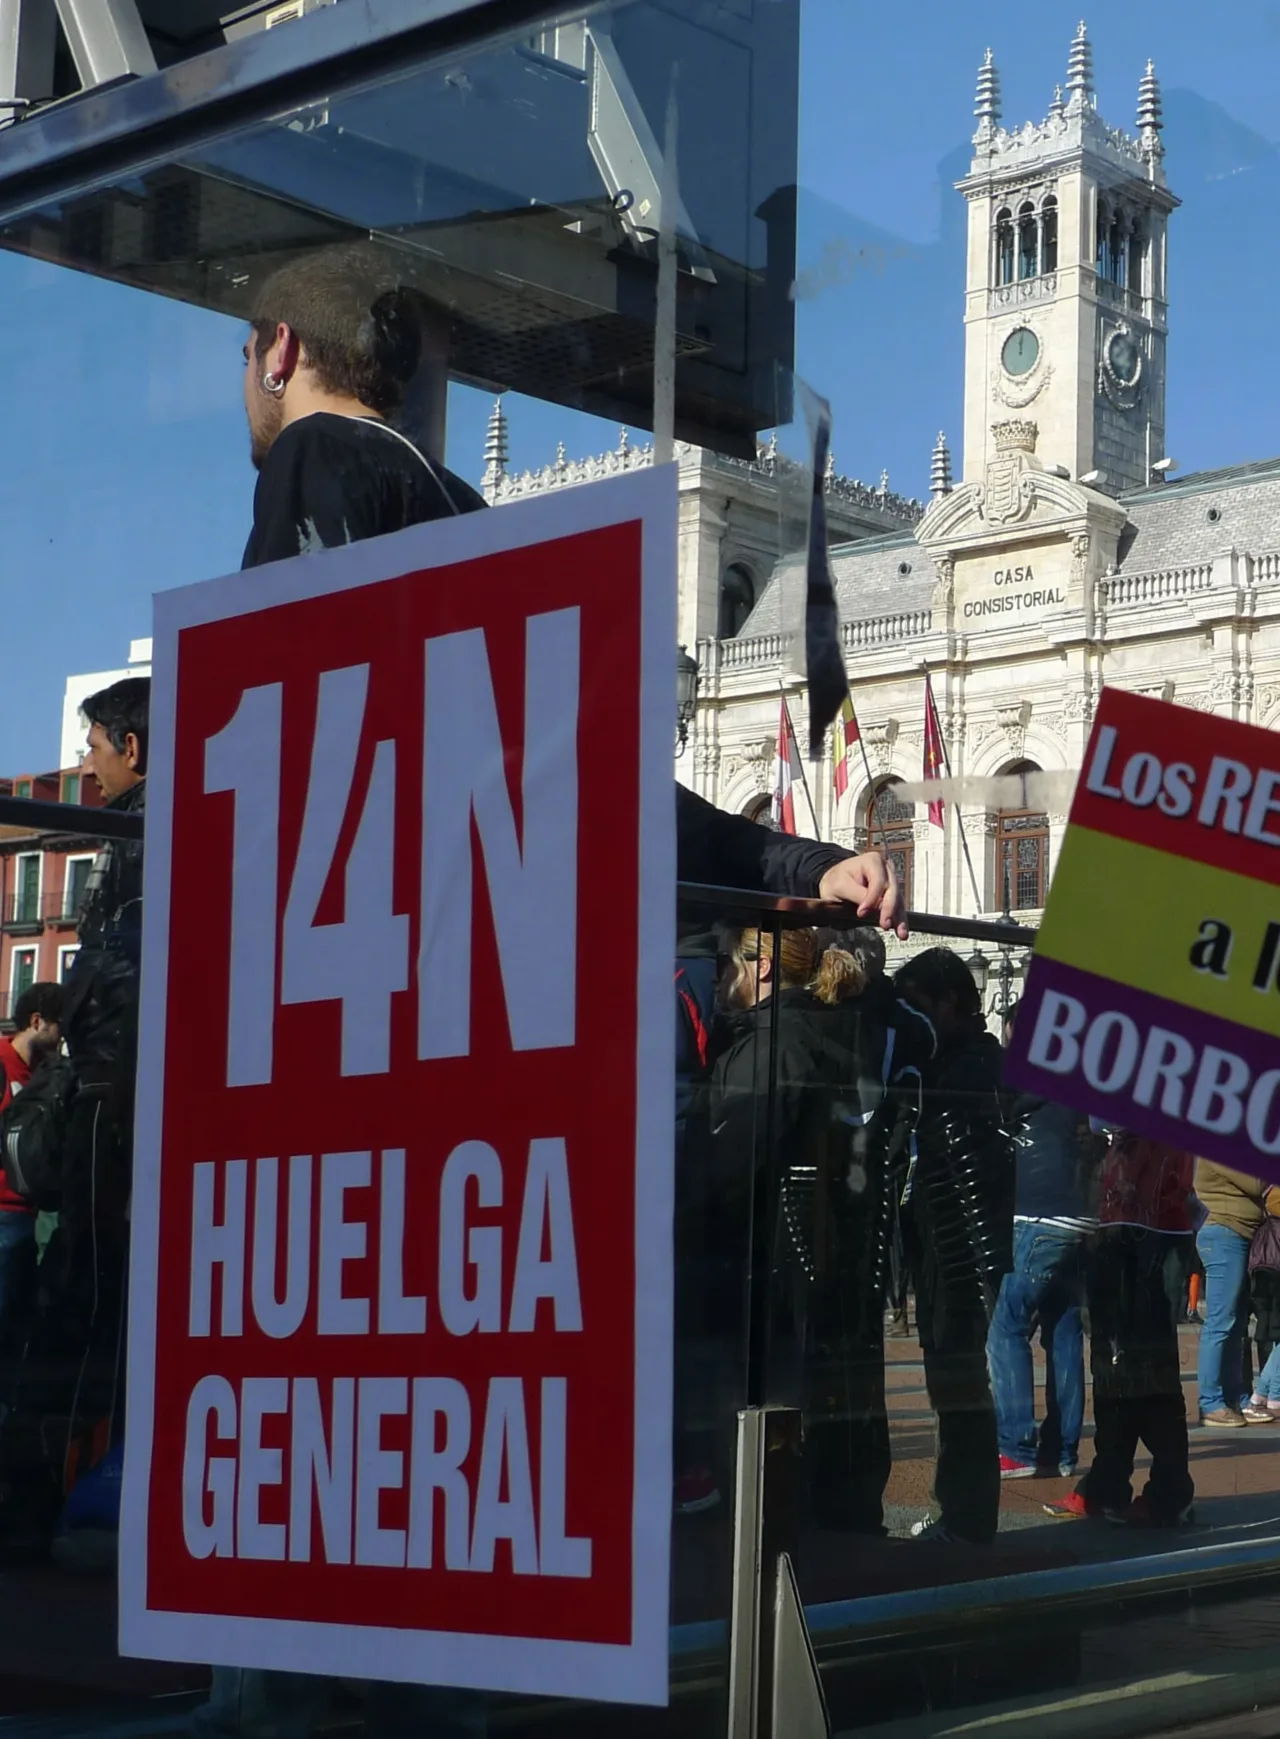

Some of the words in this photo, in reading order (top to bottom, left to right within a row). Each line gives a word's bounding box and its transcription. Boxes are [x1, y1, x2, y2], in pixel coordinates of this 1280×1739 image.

[963, 588, 1064, 618] CONSISTORIAL
[994, 565, 1034, 586] CASA
[204, 605, 580, 1087] 14N
[1188, 917, 1234, 978] a
[189, 1137, 583, 1339] HUELGA
[182, 1374, 592, 1578] GENERAL
